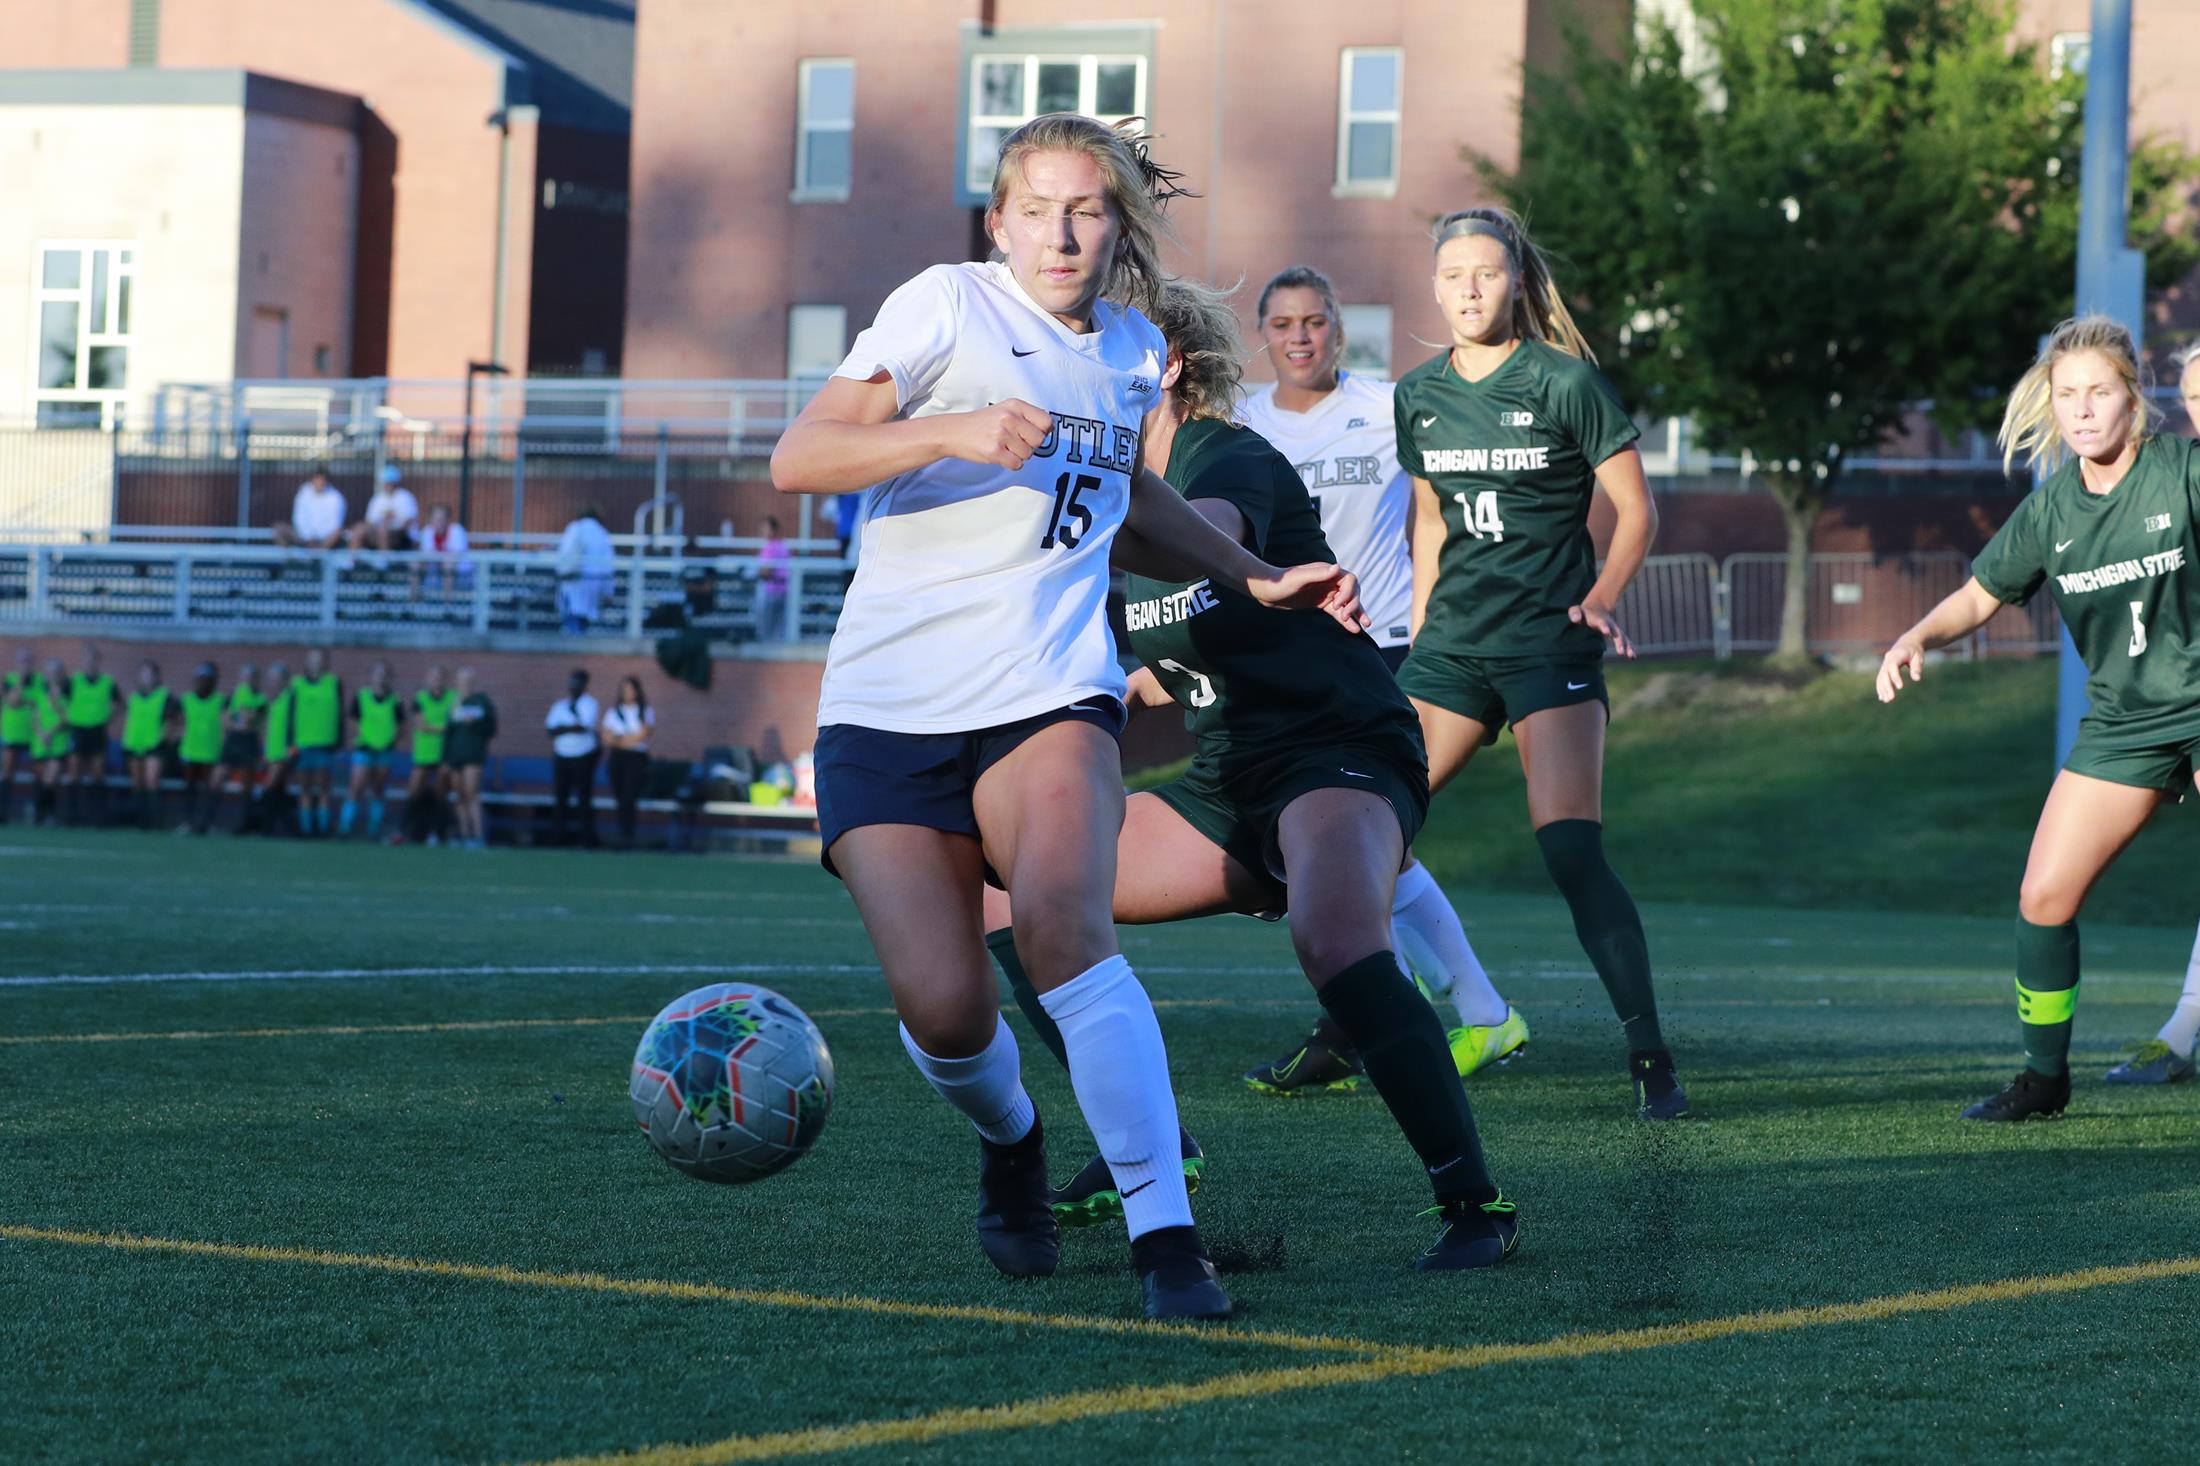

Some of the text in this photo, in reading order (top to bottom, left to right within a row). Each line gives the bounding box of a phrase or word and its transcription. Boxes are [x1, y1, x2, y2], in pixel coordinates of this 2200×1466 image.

[1131, 380, 1153, 393] EAST
[1033, 411, 1138, 476] UTLE
[1421, 446, 1550, 473] ICHIGAN STATE
[1040, 472, 1102, 550] 15
[1453, 490, 1504, 542] 14
[2056, 559, 2145, 595] MICHIGAN
[1125, 578, 1220, 632] IGAN STATE
[2128, 600, 2148, 657] 5
